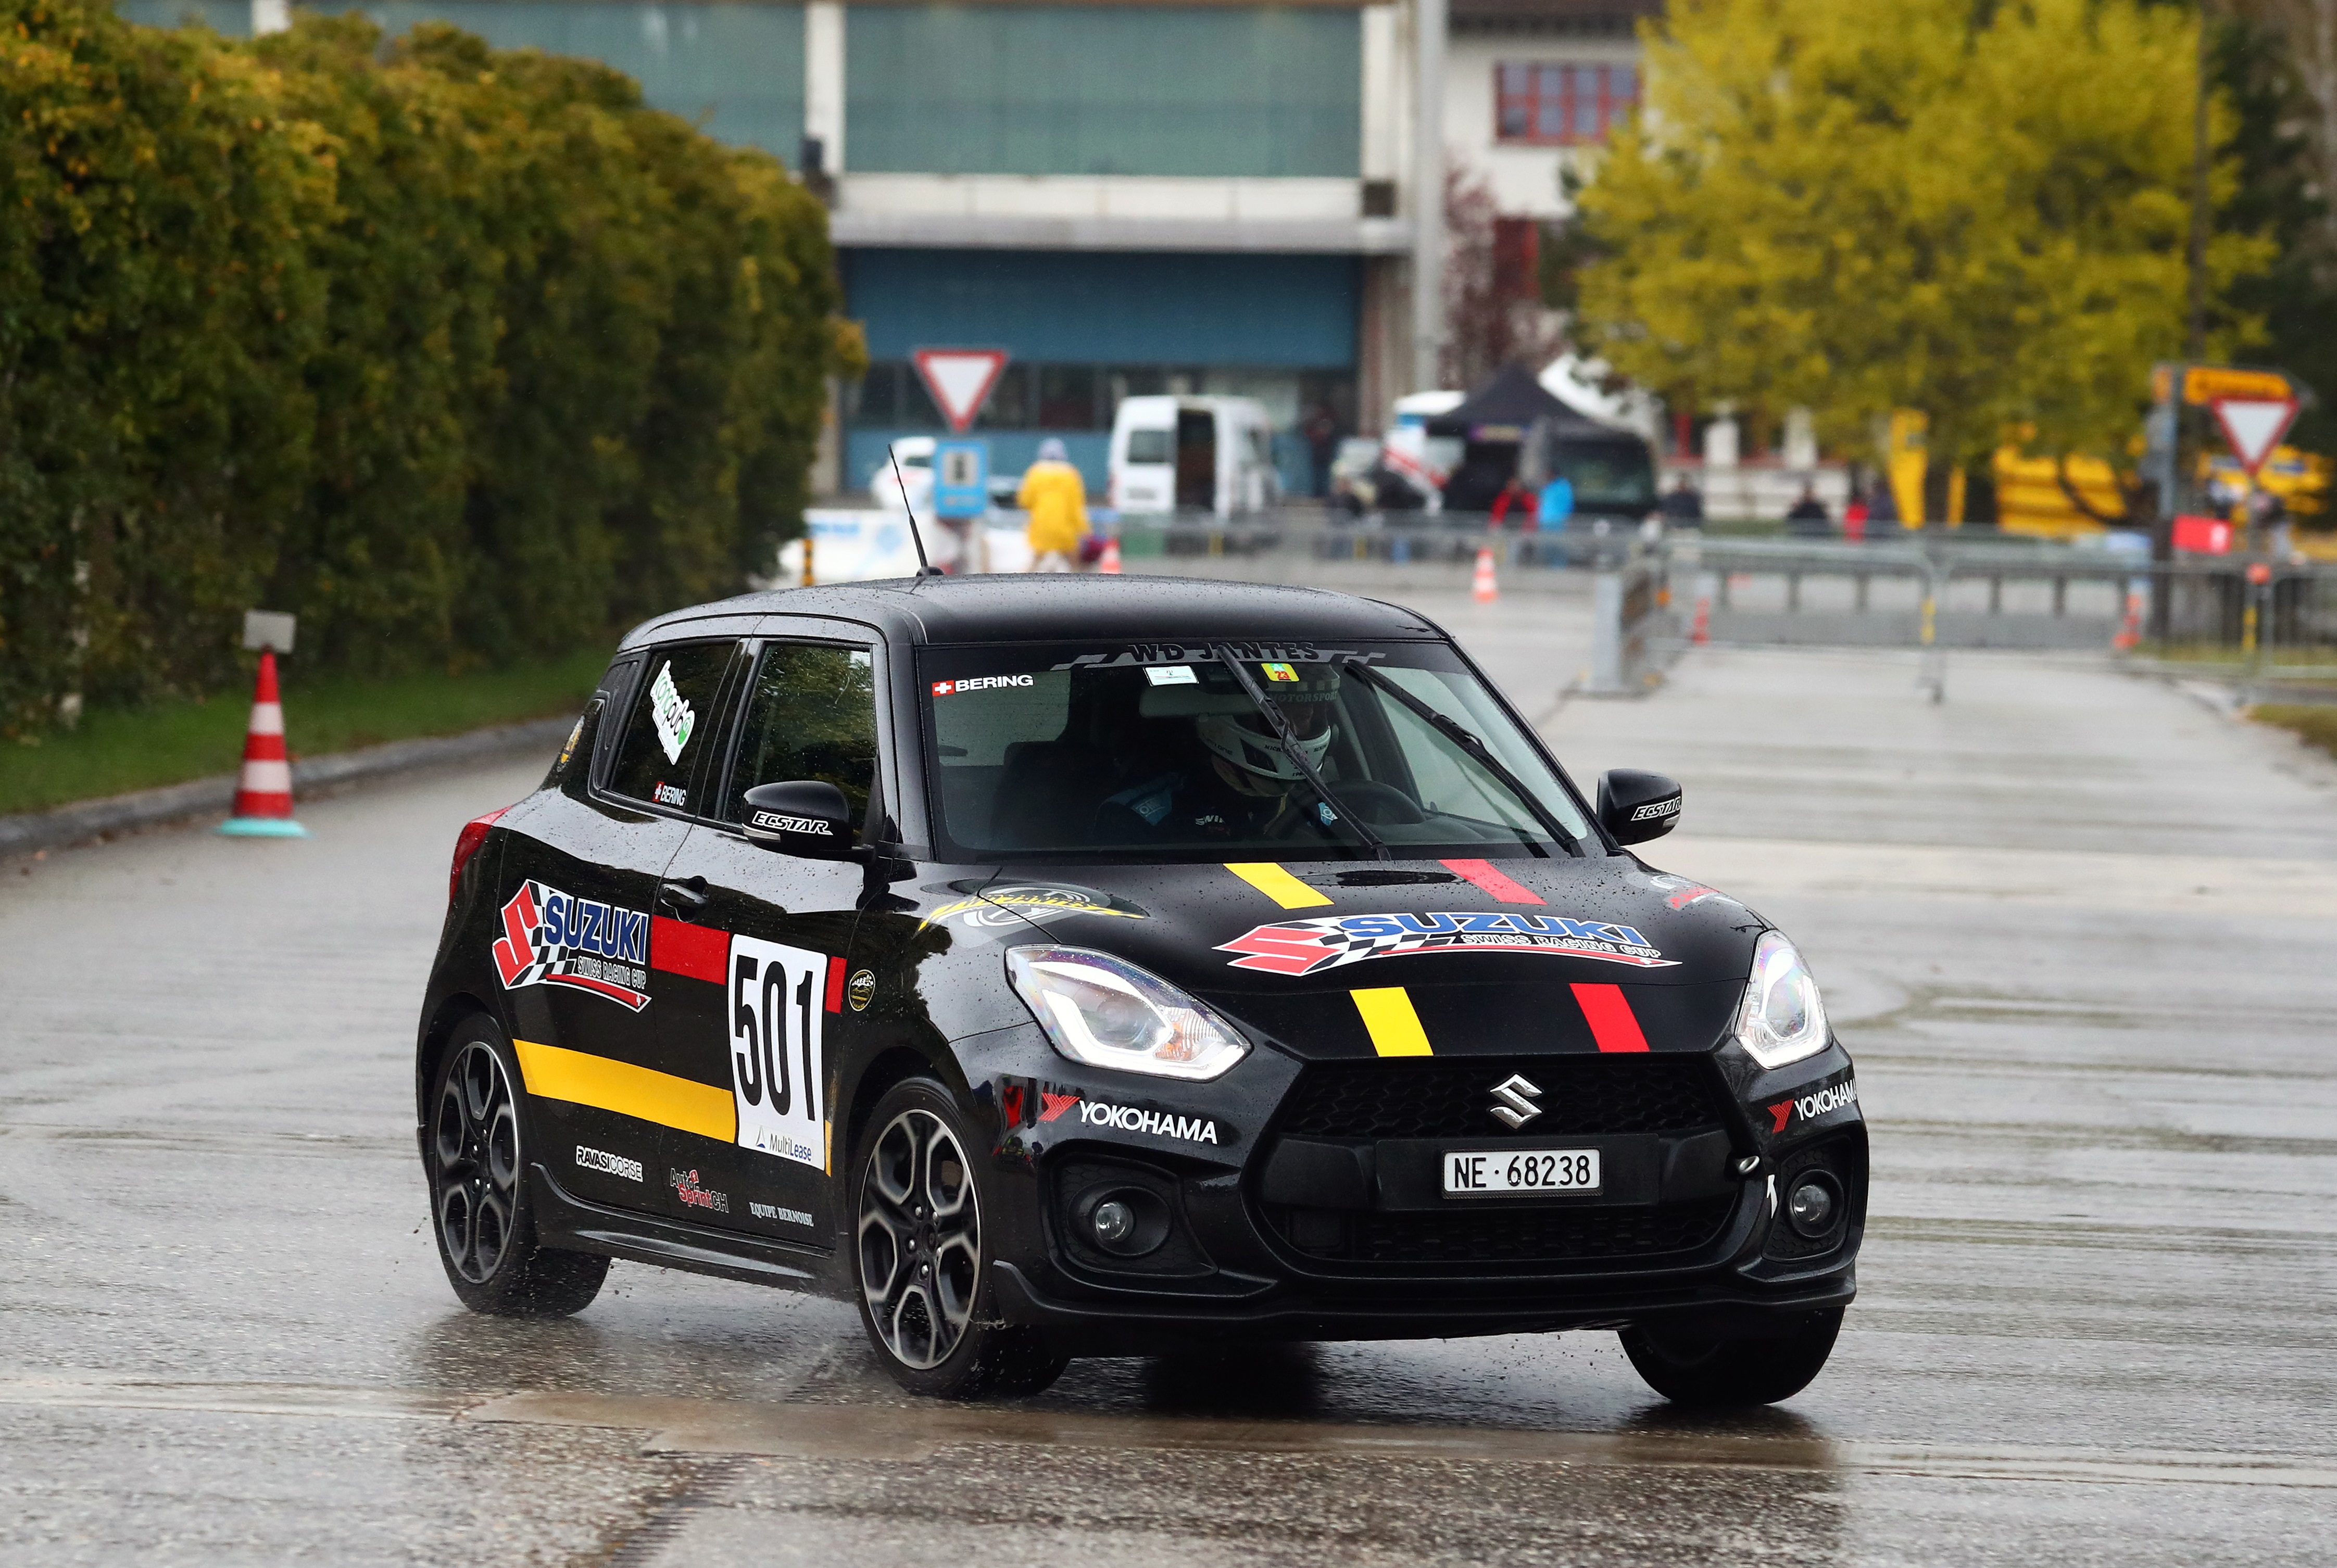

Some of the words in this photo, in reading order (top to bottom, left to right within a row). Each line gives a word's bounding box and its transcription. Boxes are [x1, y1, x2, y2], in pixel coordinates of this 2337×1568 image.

[1128, 644, 1185, 662] WD
[955, 675, 1034, 692] BERING
[1274, 671, 1290, 680] 23
[660, 785, 686, 806] BERING
[752, 811, 833, 835] ECSTAR
[544, 894, 649, 965] SUZUKI
[1340, 912, 1652, 946] SUZUKI
[1461, 934, 1532, 945] SWISS
[1534, 935, 1617, 952] RACING
[1619, 945, 1662, 958] CUP
[577, 956, 602, 979] SWISS
[602, 962, 631, 986] RACING
[631, 968, 647, 990] CUP
[734, 955, 815, 1122] 501
[1079, 1100, 1217, 1144] YOKOHAMA
[770, 1133, 812, 1161] MultiLease
[749, 1202, 777, 1219] EQUIPE
[777, 1207, 814, 1227] BERNOISE
